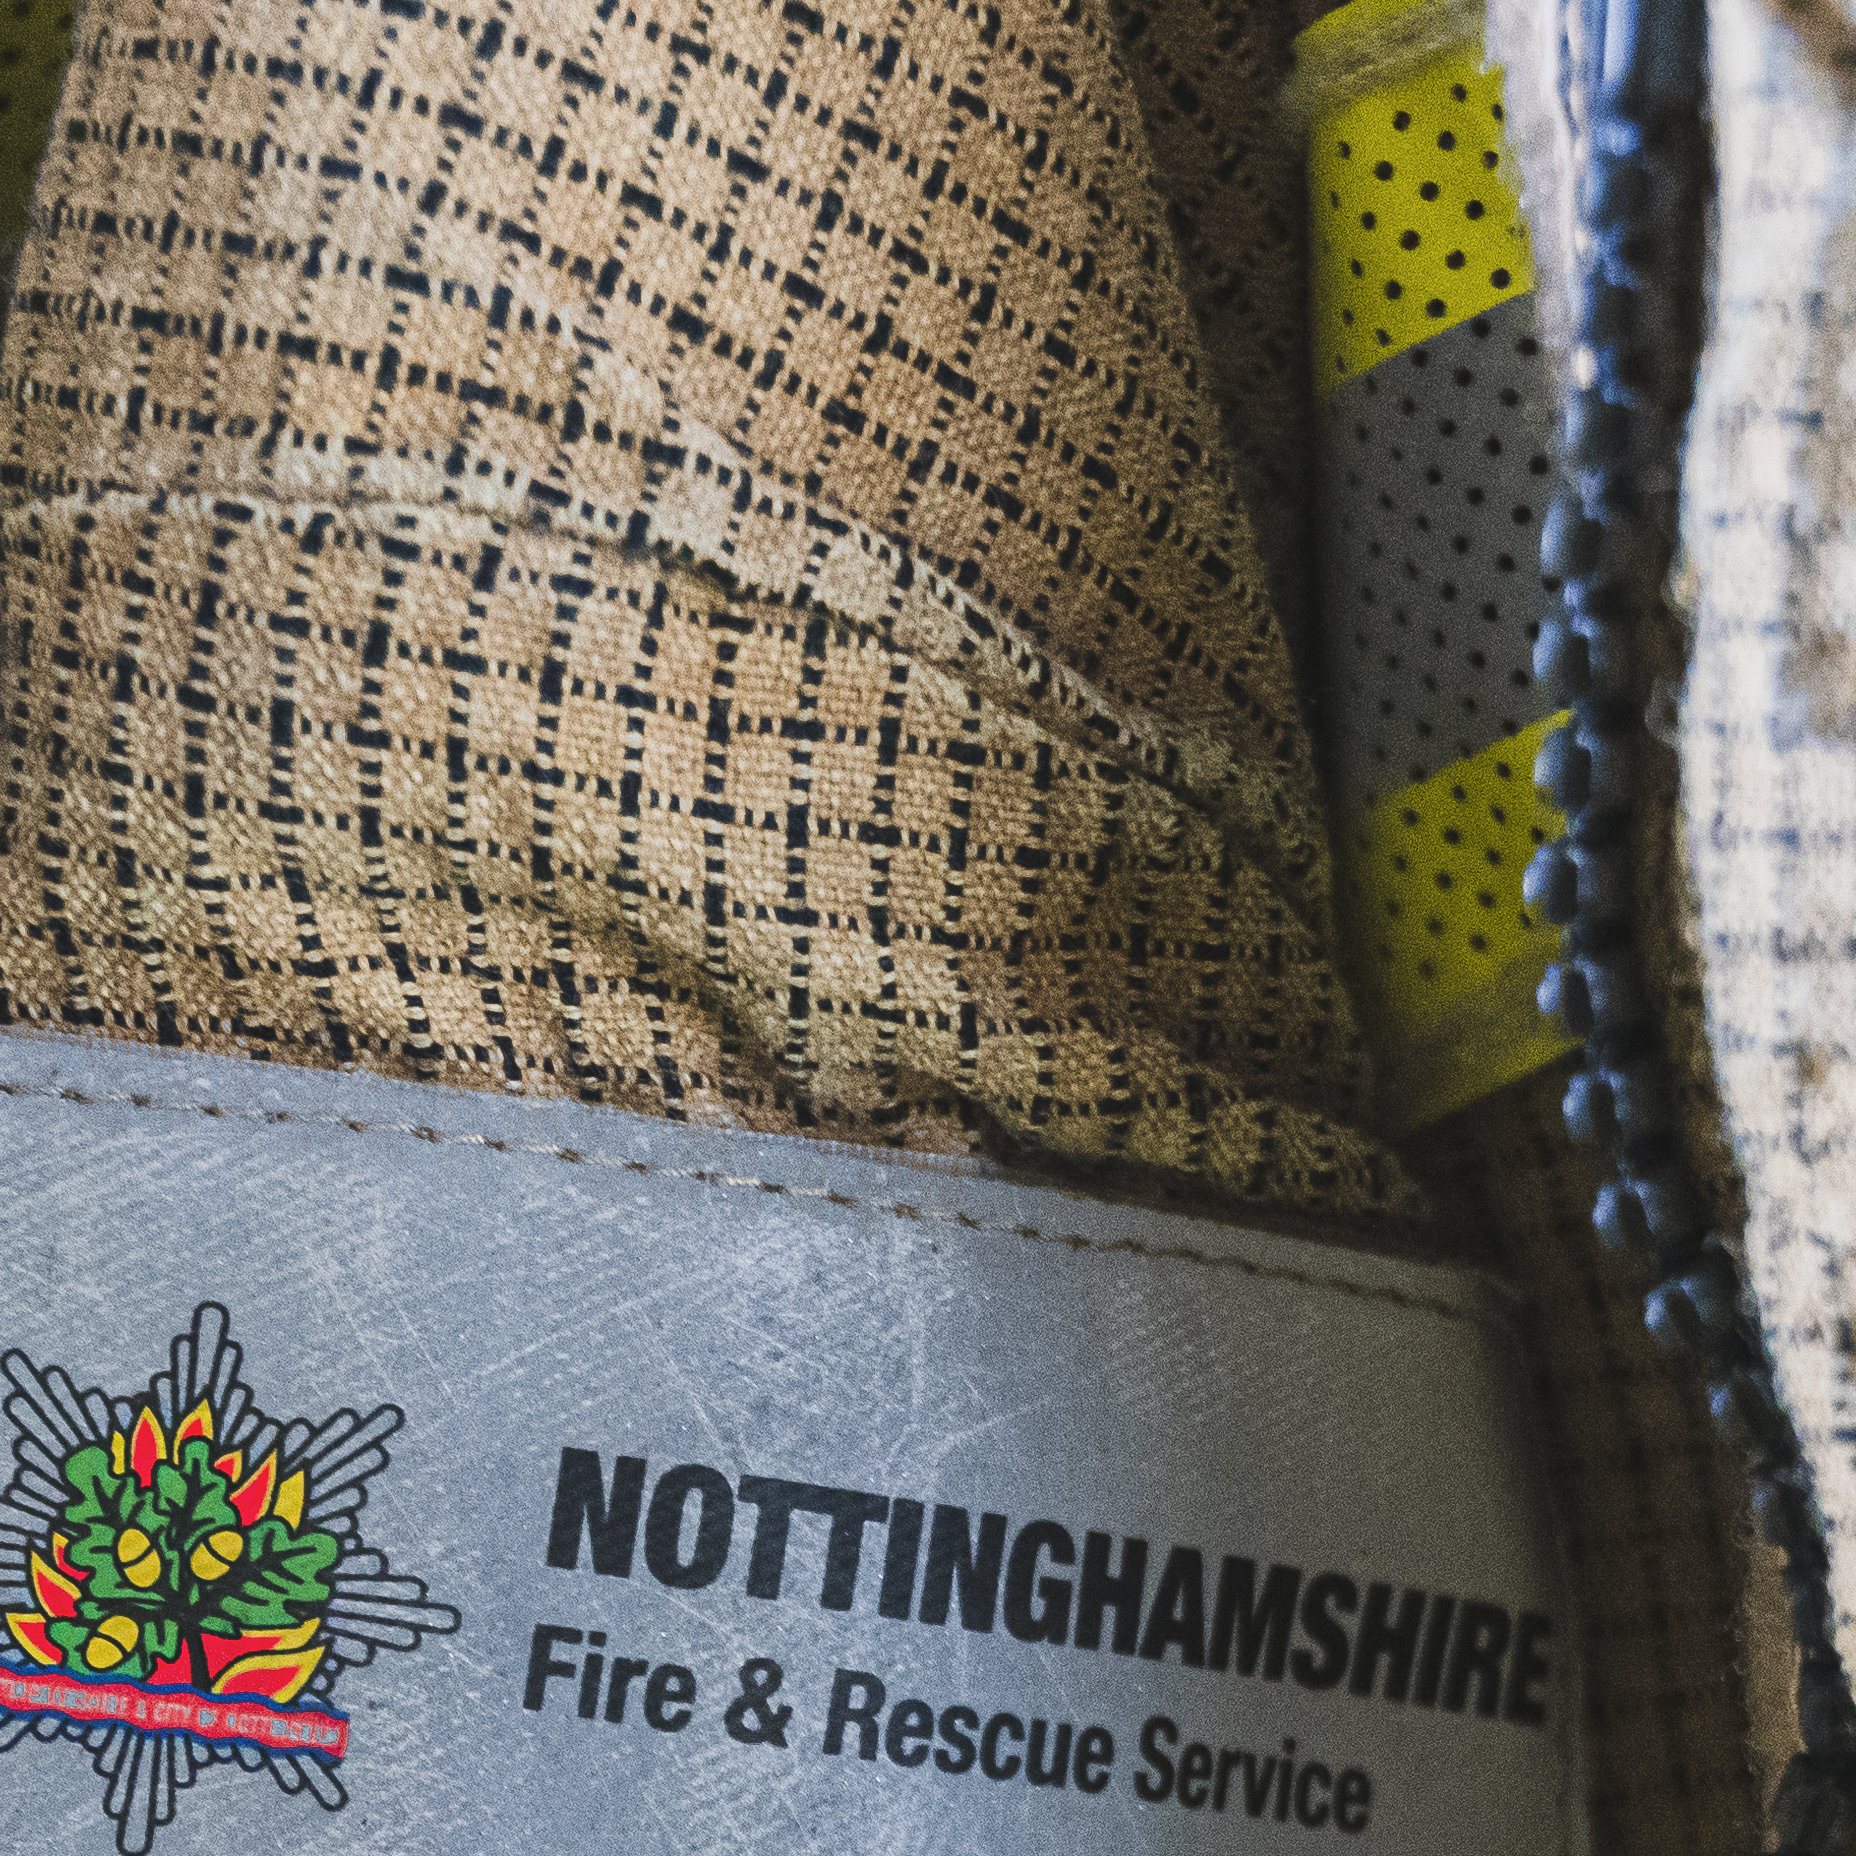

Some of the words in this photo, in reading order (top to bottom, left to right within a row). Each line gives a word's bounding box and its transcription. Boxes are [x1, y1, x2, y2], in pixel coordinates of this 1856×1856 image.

[546, 1446, 1550, 1726] NOTTINGHAMSHIRE
[523, 1622, 697, 1733] Fire
[724, 1657, 794, 1748] &
[822, 1667, 1115, 1795] Rescue
[1133, 1715, 1372, 1834] Service
